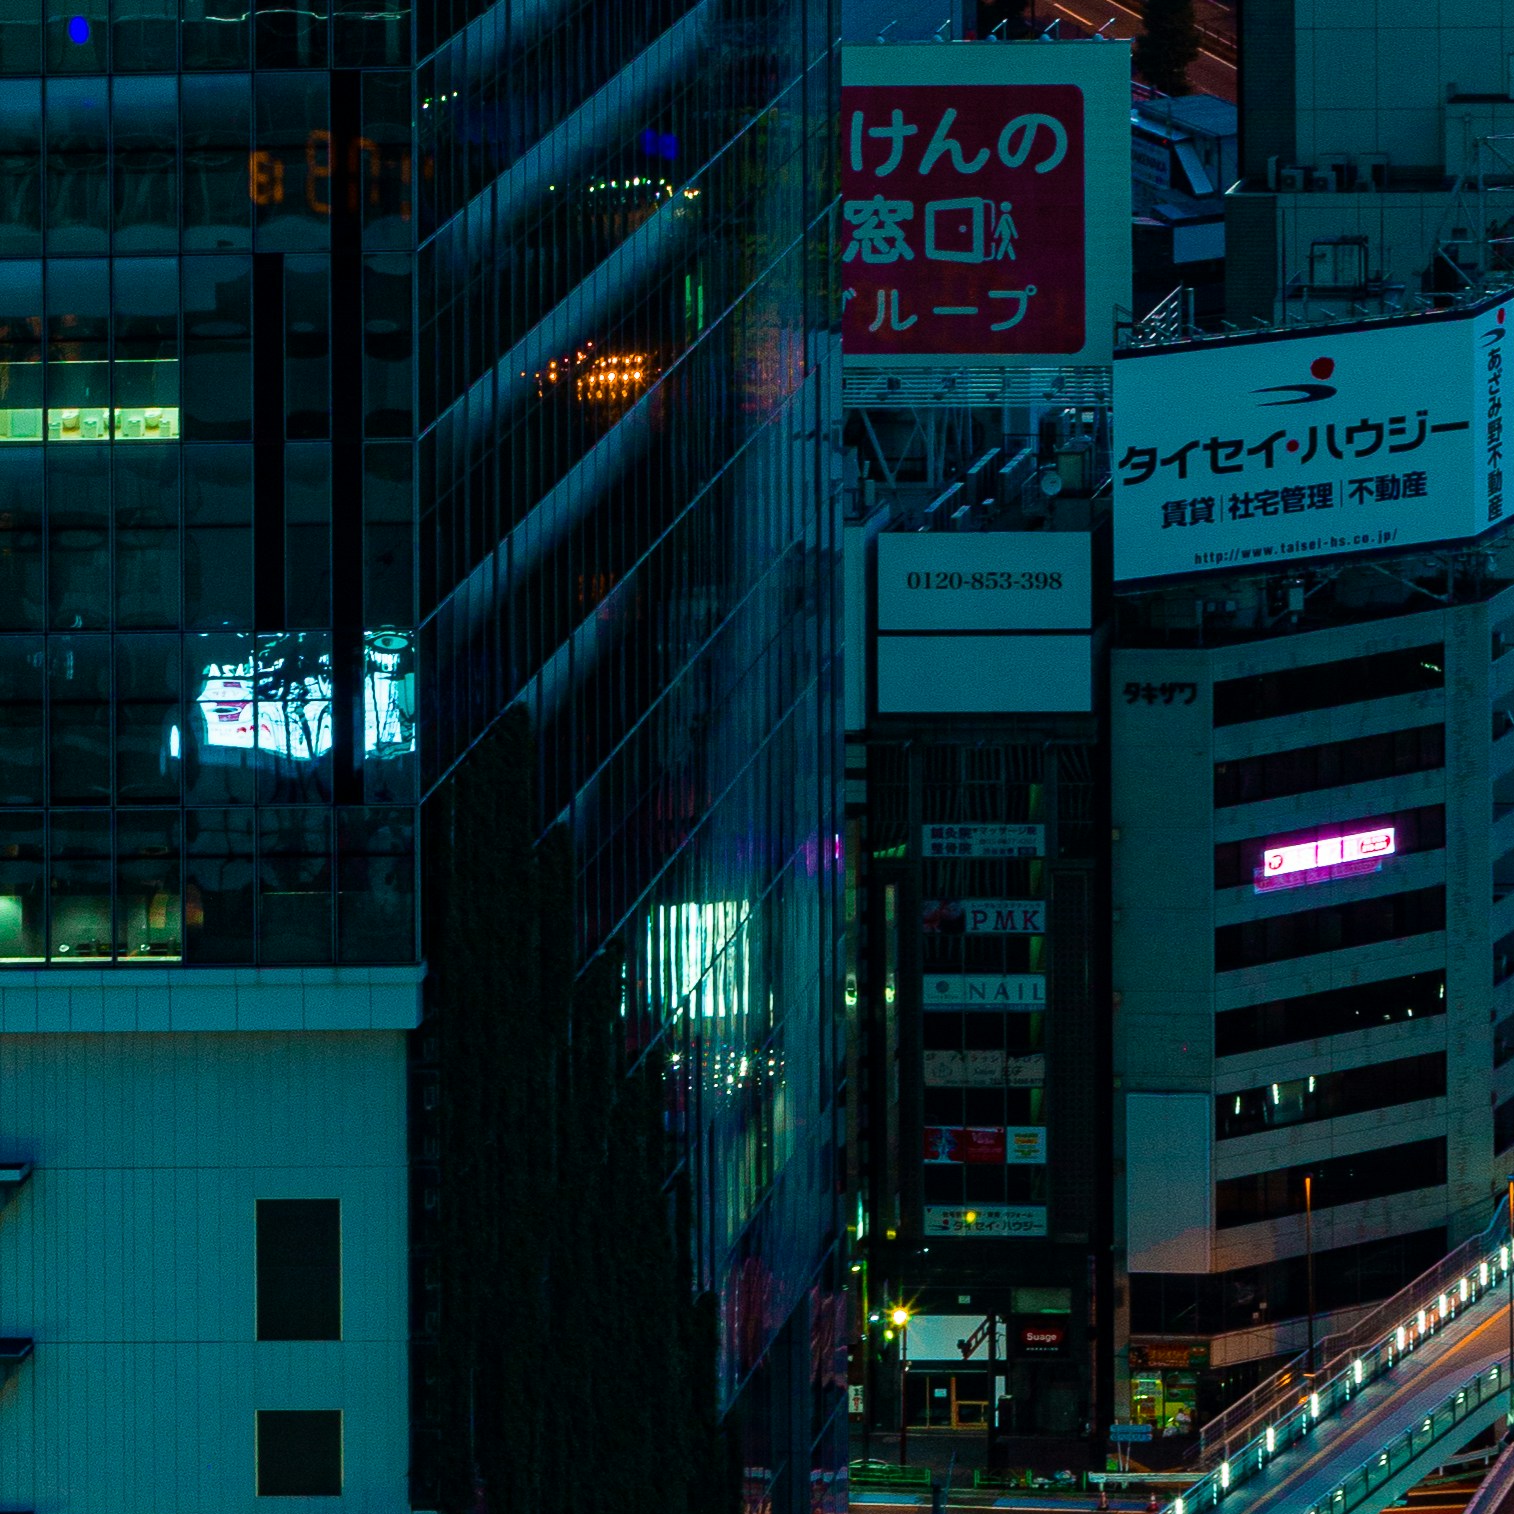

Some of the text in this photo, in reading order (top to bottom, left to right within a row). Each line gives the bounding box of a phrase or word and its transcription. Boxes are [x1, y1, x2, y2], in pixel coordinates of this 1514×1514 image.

[851, 107, 1068, 177] けんの
[842, 194, 986, 264] 窓口
[1119, 410, 1470, 486] タイセイ・ハウジー
[1161, 470, 1428, 528] 賃貸 社宅管理 不動産
[1194, 528, 1398, 565] http://www.taisei-hs.co.jp/
[906, 571, 1063, 590] 0120-853-398
[1123, 682, 1198, 705] タキザワ
[971, 910, 1040, 931] PMK
[968, 983, 1044, 1001] NAIL
[1026, 1332, 1057, 1343] Suage
